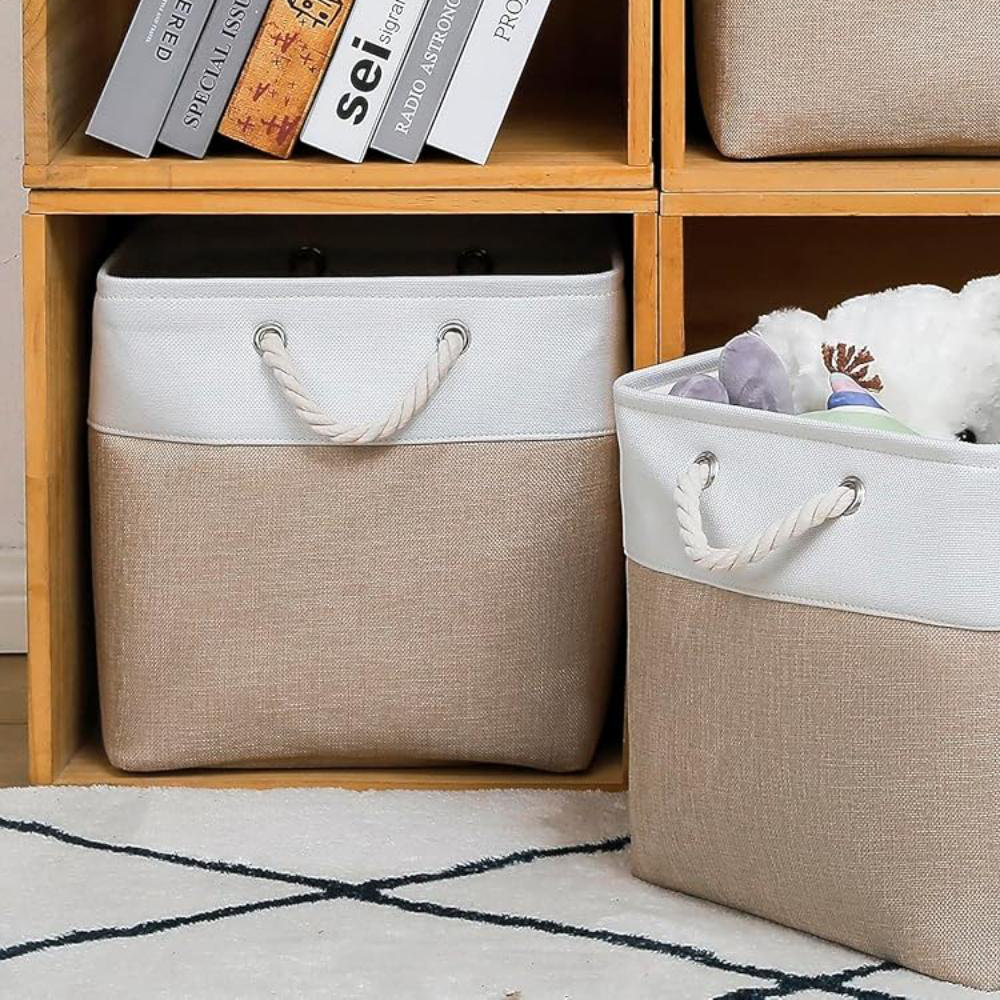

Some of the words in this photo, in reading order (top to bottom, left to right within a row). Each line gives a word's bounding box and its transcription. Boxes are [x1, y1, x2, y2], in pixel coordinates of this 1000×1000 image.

[183, 44, 232, 129] SPECIAL
[336, 36, 392, 126] sei
[394, 79, 427, 135] RADIO
